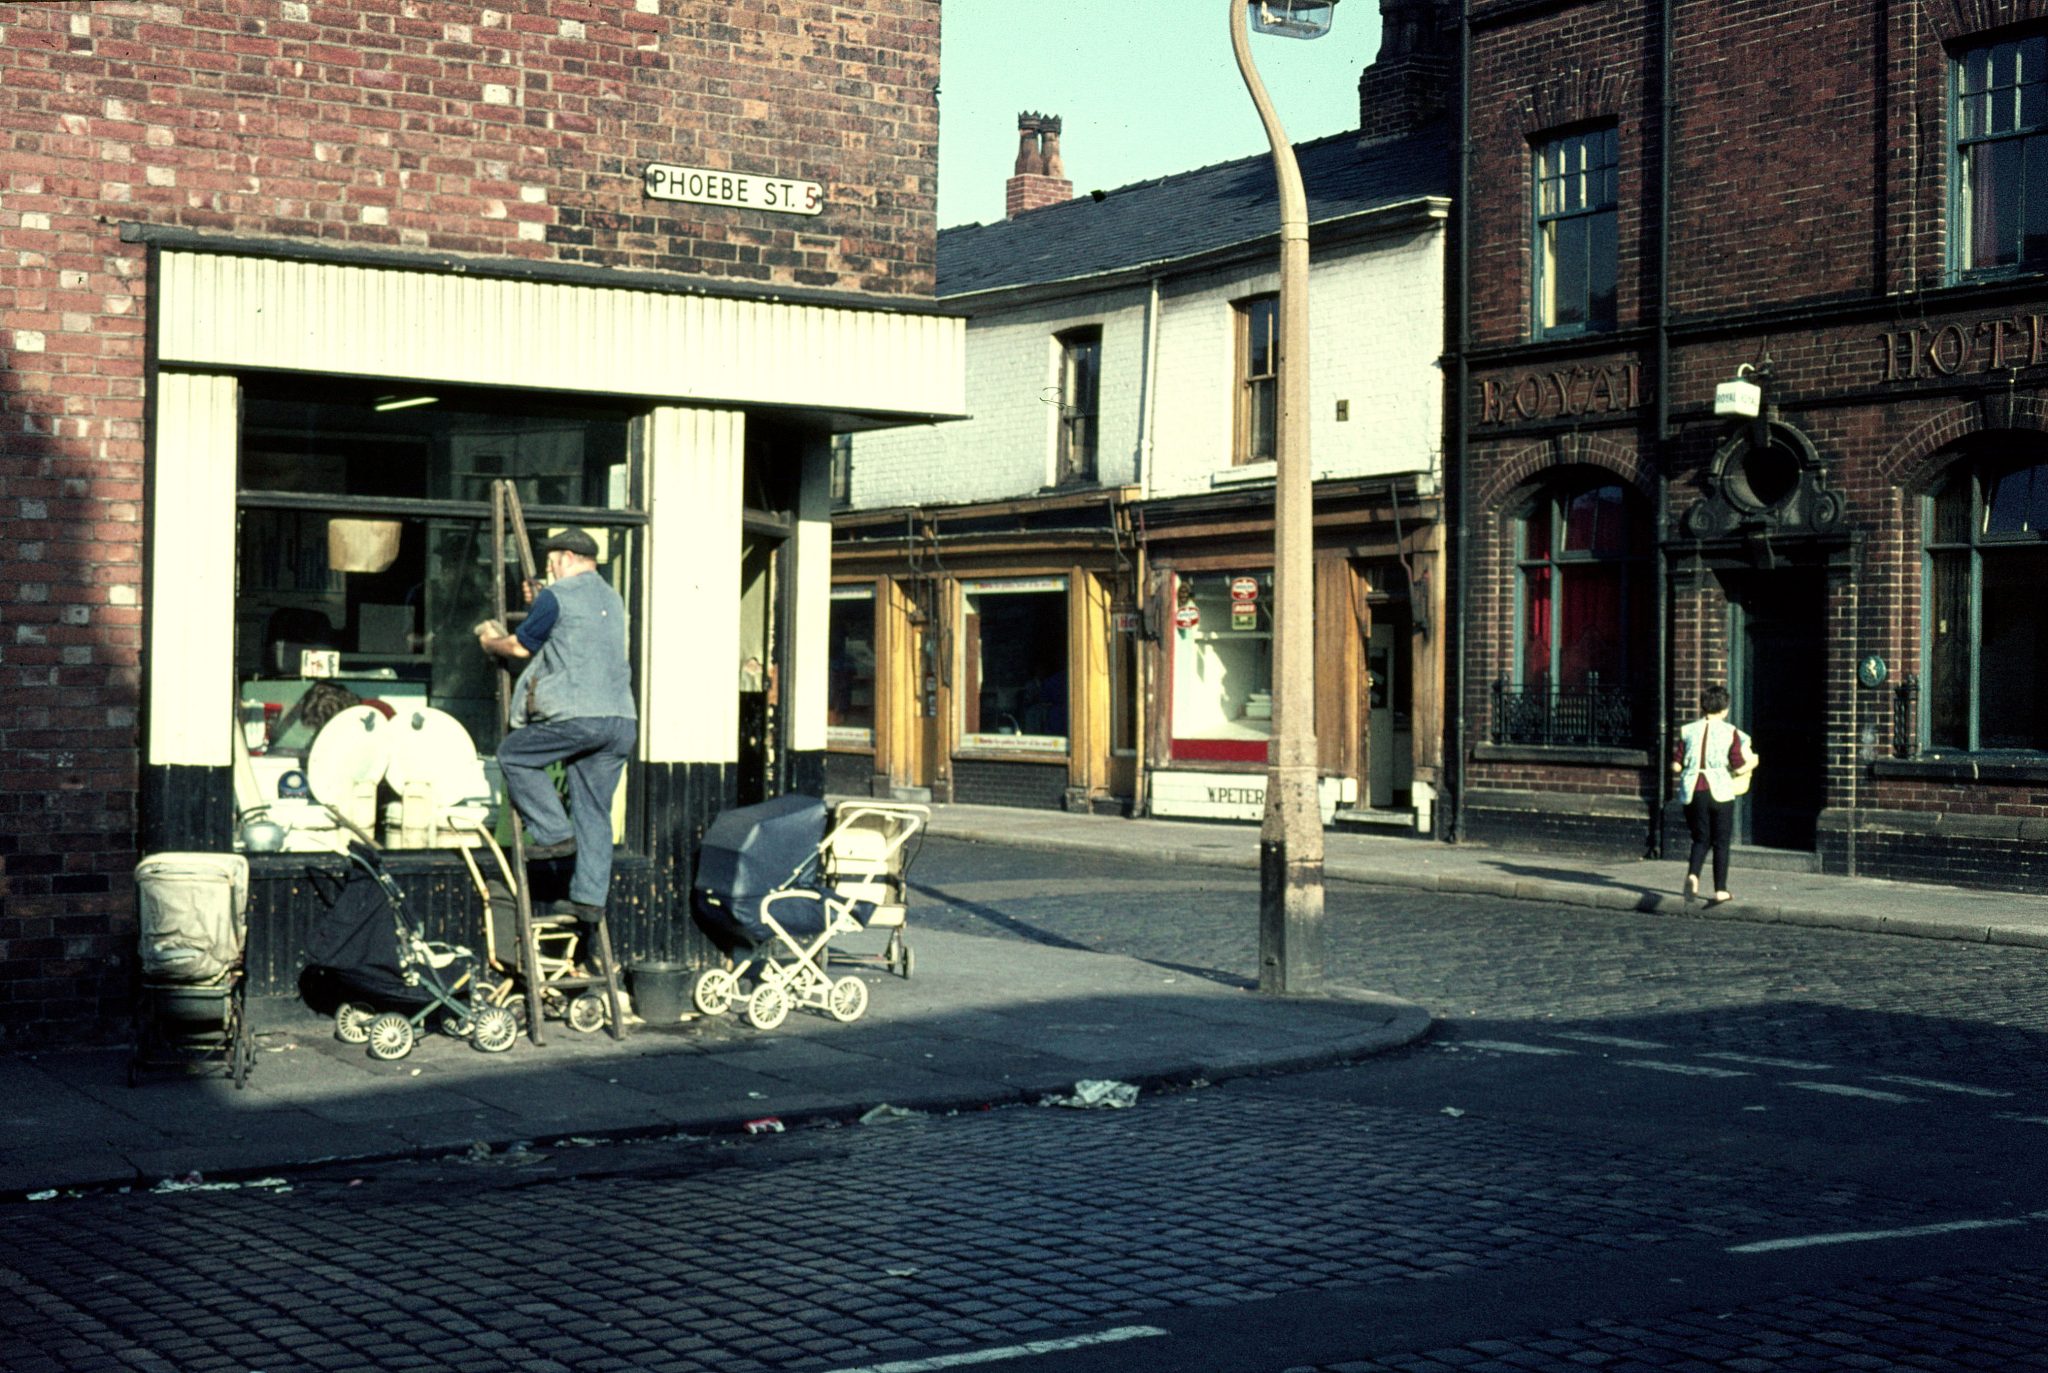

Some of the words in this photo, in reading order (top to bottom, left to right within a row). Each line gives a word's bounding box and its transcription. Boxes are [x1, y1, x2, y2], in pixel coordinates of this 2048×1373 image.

[653, 169, 749, 202] PHOEBE
[764, 182, 796, 208] ST.
[805, 186, 817, 209] 5
[1481, 361, 1652, 424] ROYAL
